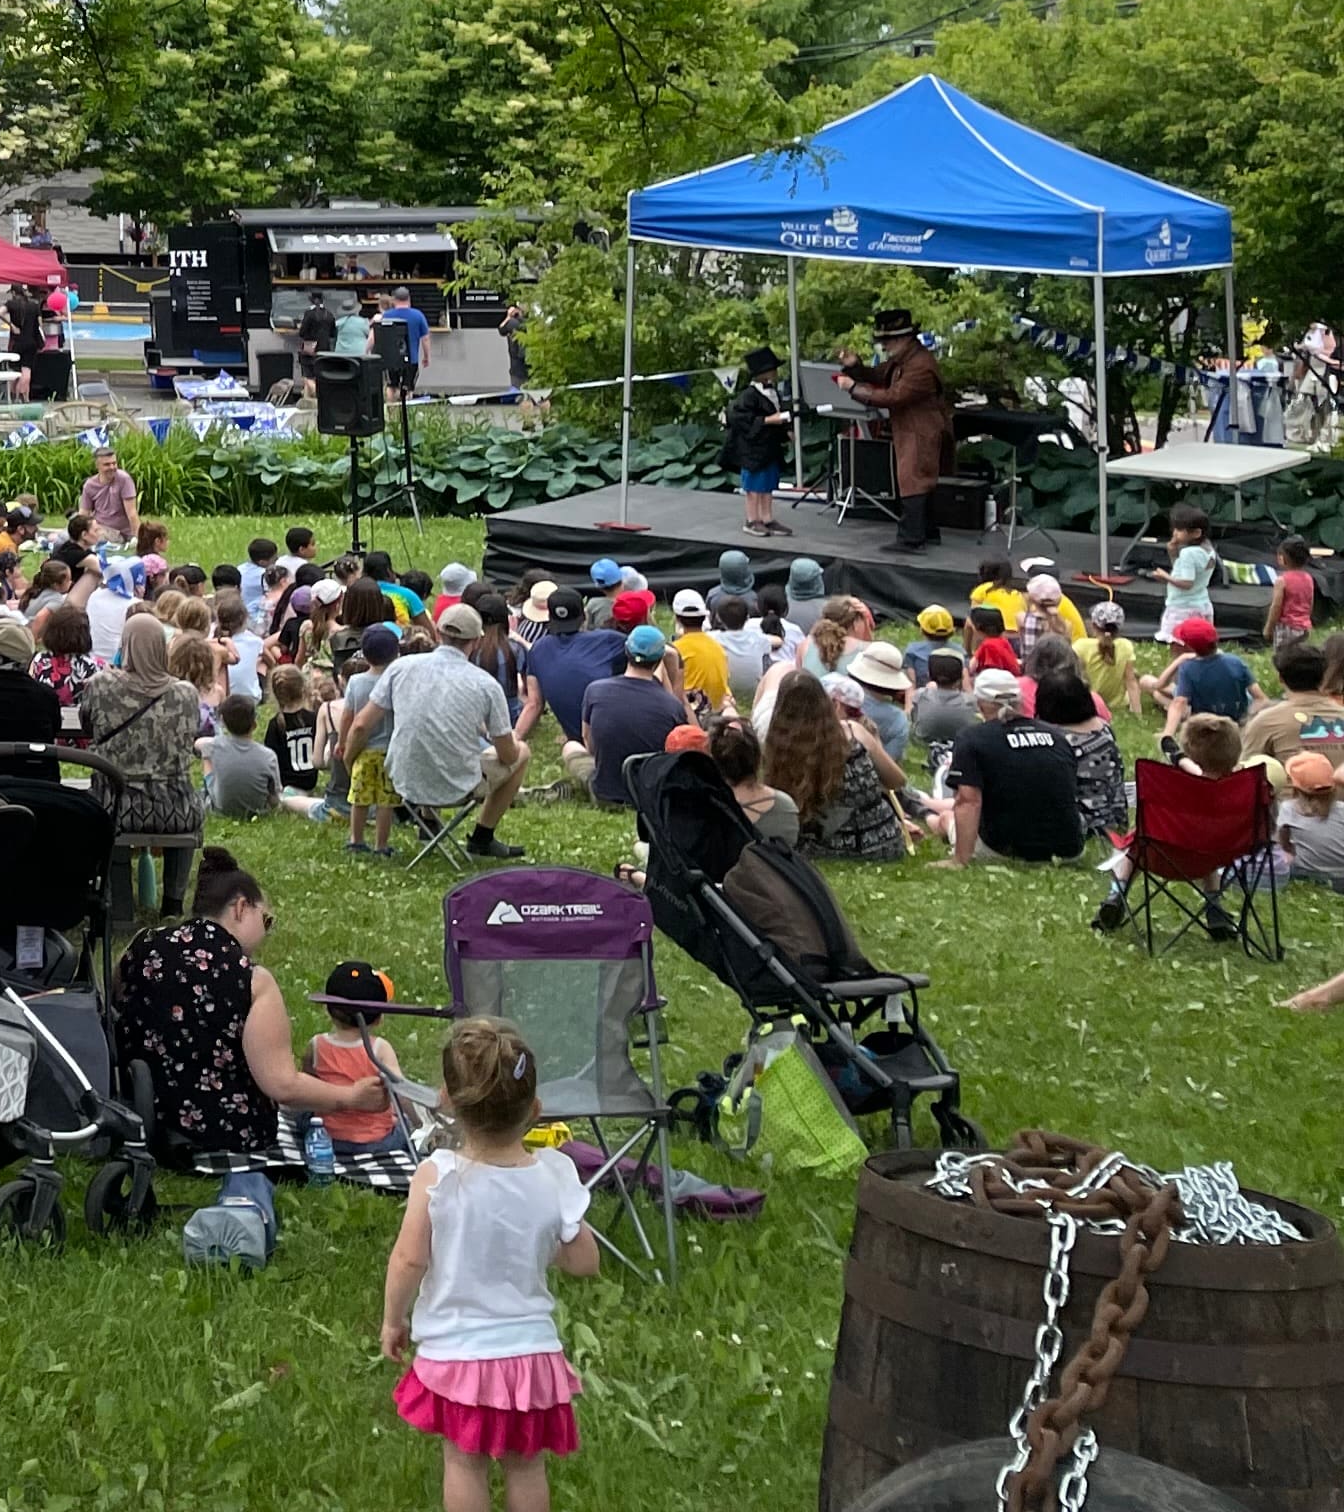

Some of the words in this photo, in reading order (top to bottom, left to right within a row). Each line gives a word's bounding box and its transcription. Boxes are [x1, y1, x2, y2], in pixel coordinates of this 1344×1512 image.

[781, 221, 806, 231] VILLE
[809, 223, 821, 232] DE
[169, 250, 208, 267] ITH
[287, 737, 313, 771] 10
